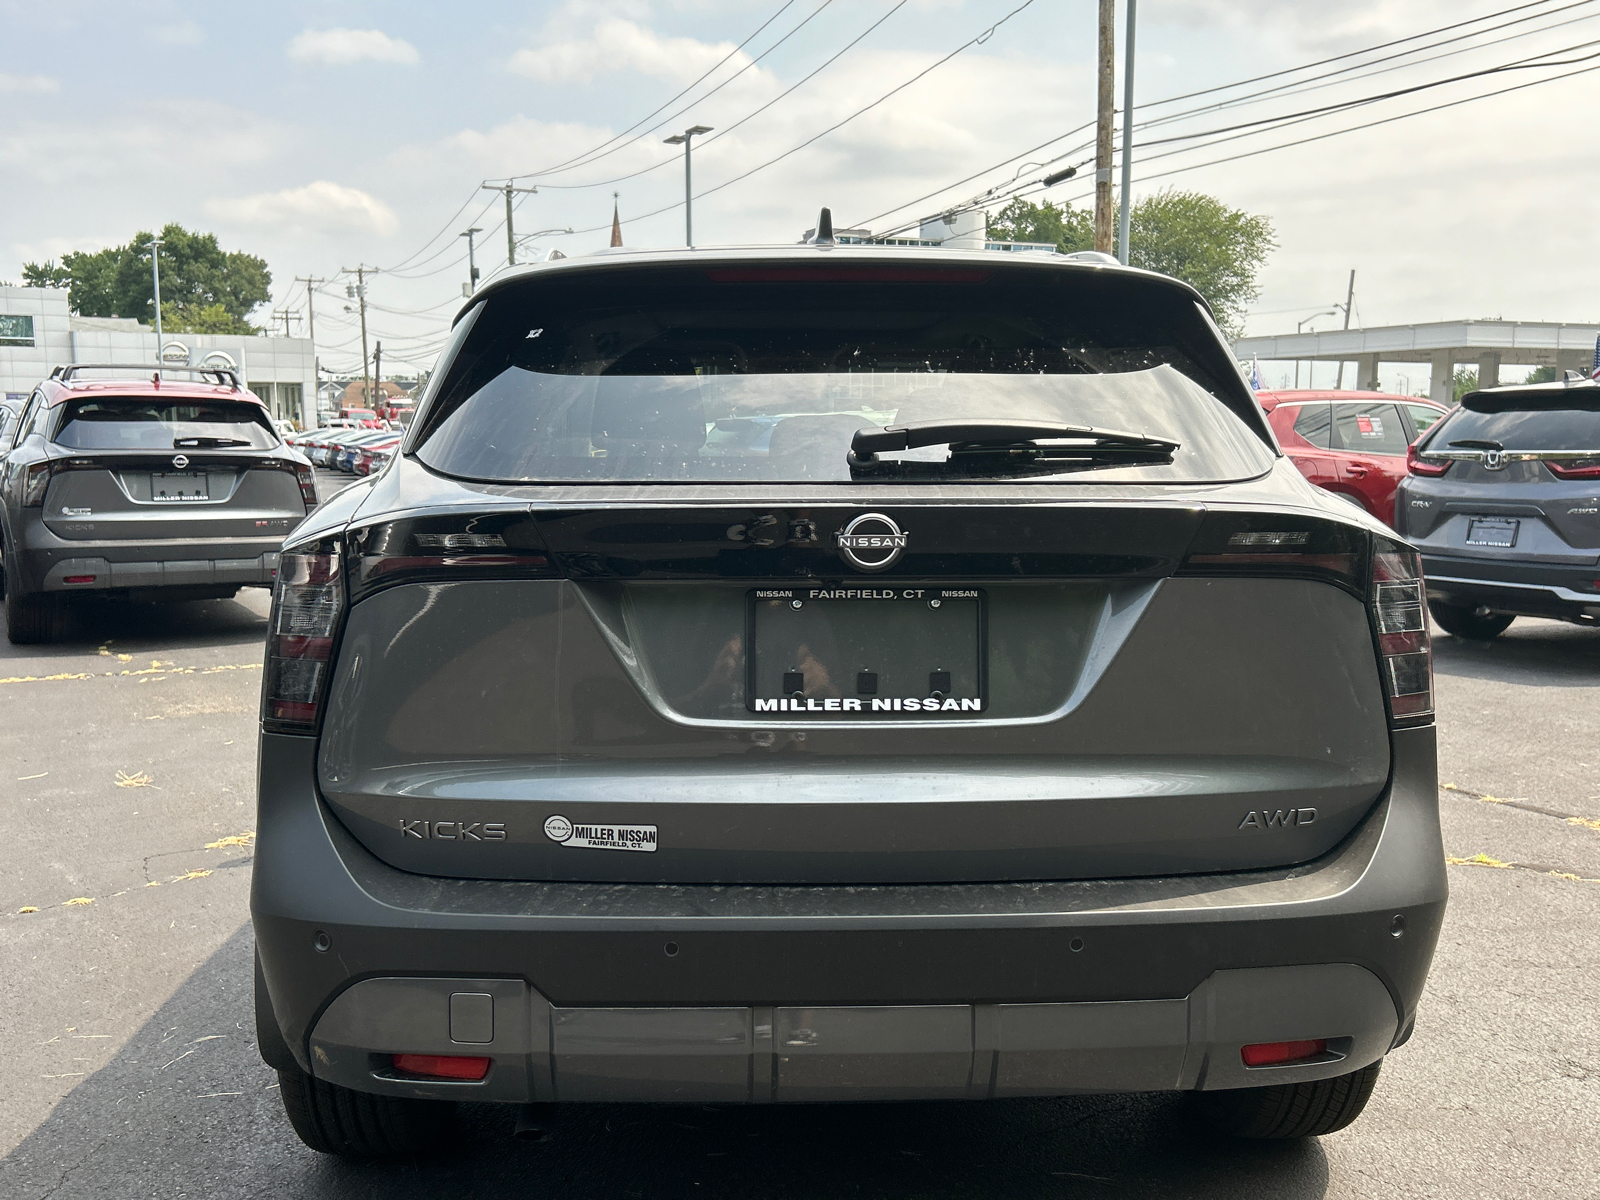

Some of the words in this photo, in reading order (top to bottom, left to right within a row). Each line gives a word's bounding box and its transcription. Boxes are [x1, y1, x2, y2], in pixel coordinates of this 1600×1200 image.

[839, 537, 905, 547] NISSAN
[756, 590, 793, 598] NISSAN
[809, 589, 898, 600] FAIRFIELD,
[902, 589, 926, 599] CT
[755, 698, 862, 712] MILLER
[871, 698, 981, 712] NISSAN
[1238, 807, 1318, 830] AWD
[399, 819, 508, 841] KICKS
[575, 826, 615, 841] MILLER
[618, 829, 656, 844] NISSAN
[588, 839, 630, 849] FAIRFIELD,
[631, 841, 643, 849] CT.
